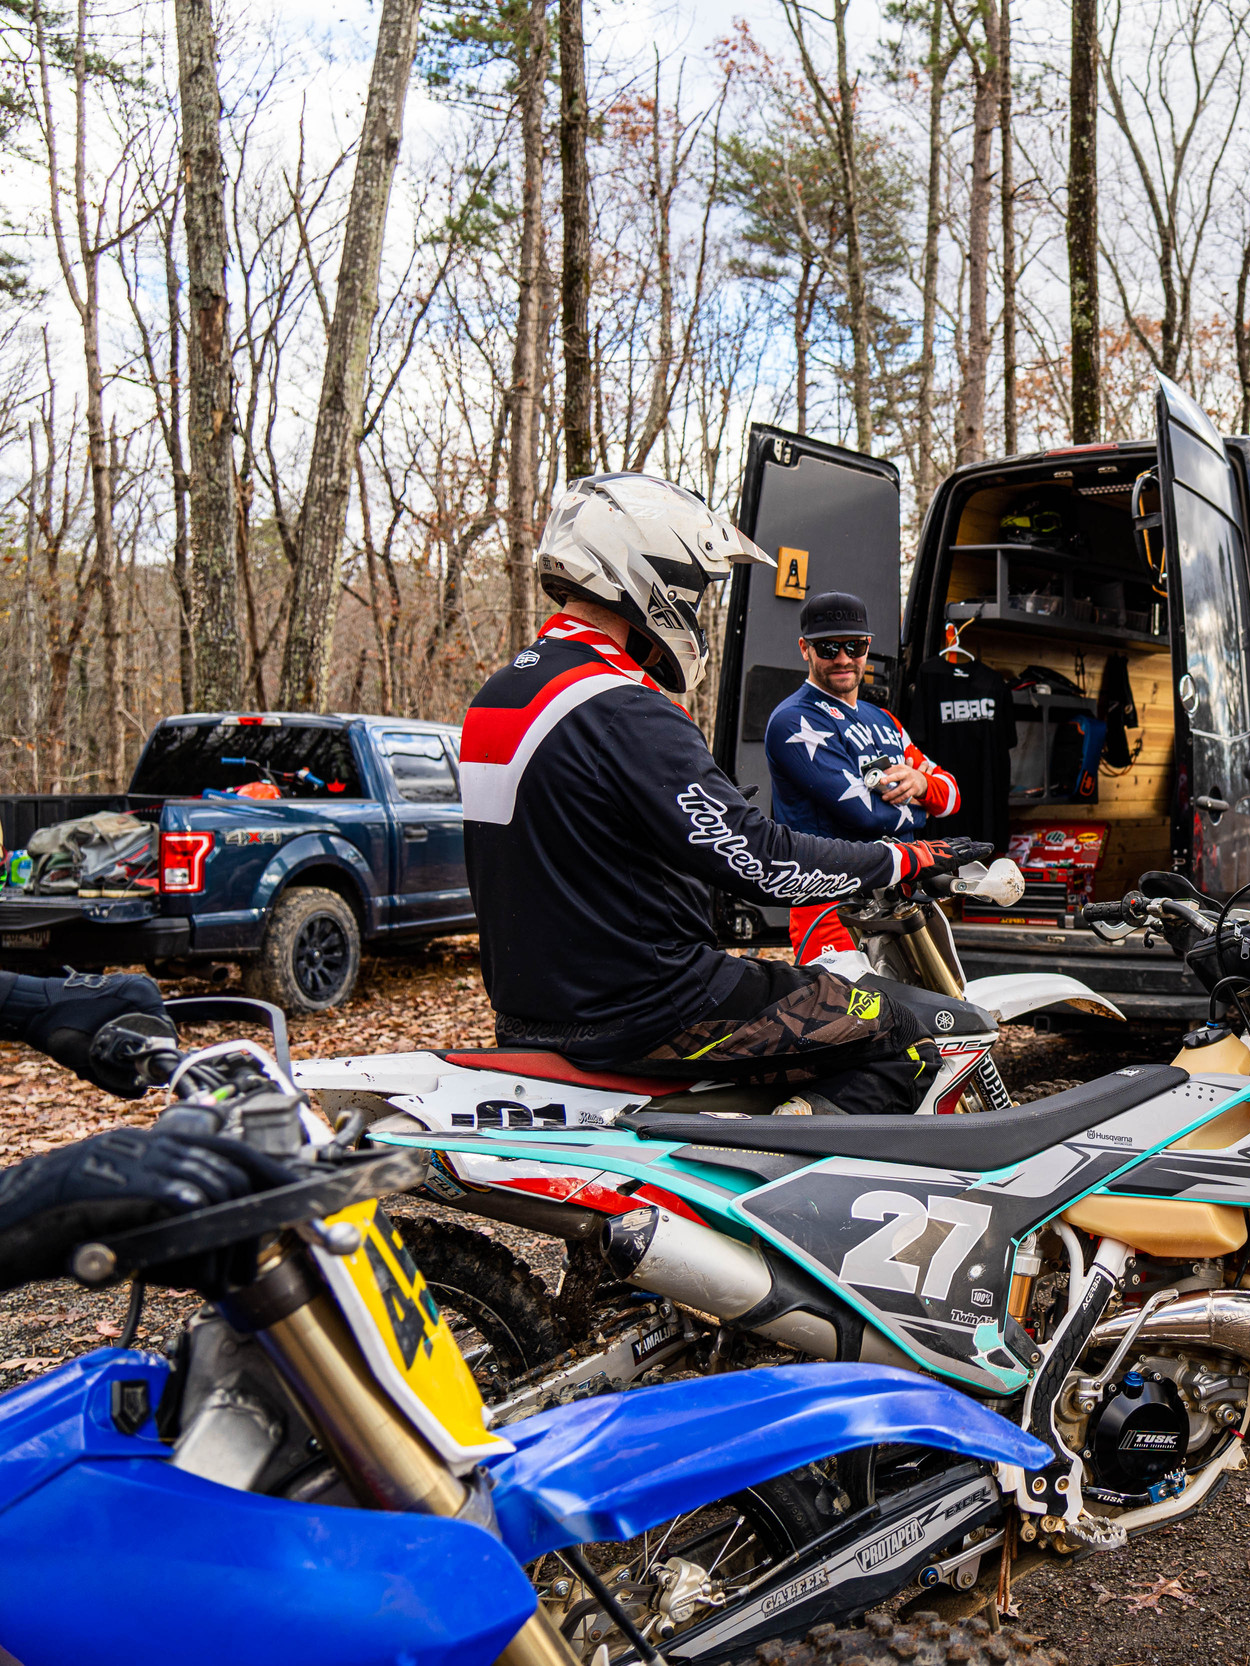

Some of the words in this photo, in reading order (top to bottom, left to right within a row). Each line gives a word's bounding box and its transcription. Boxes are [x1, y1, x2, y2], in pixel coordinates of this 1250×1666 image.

[826, 610, 863, 622] ROYAL
[677, 783, 732, 844] Troy
[714, 834, 764, 881] Lee
[758, 860, 862, 905] Designs
[1096, 1132, 1132, 1143] Husqvarna
[838, 1189, 993, 1301] 27
[973, 1290, 991, 1304] 100%
[1135, 1434, 1178, 1445] TUSK
[944, 1486, 992, 1520] EXCEL
[1097, 1493, 1125, 1504] TUSK
[861, 1522, 921, 1569] PROTAPER
[761, 1568, 828, 1614] GALFER
